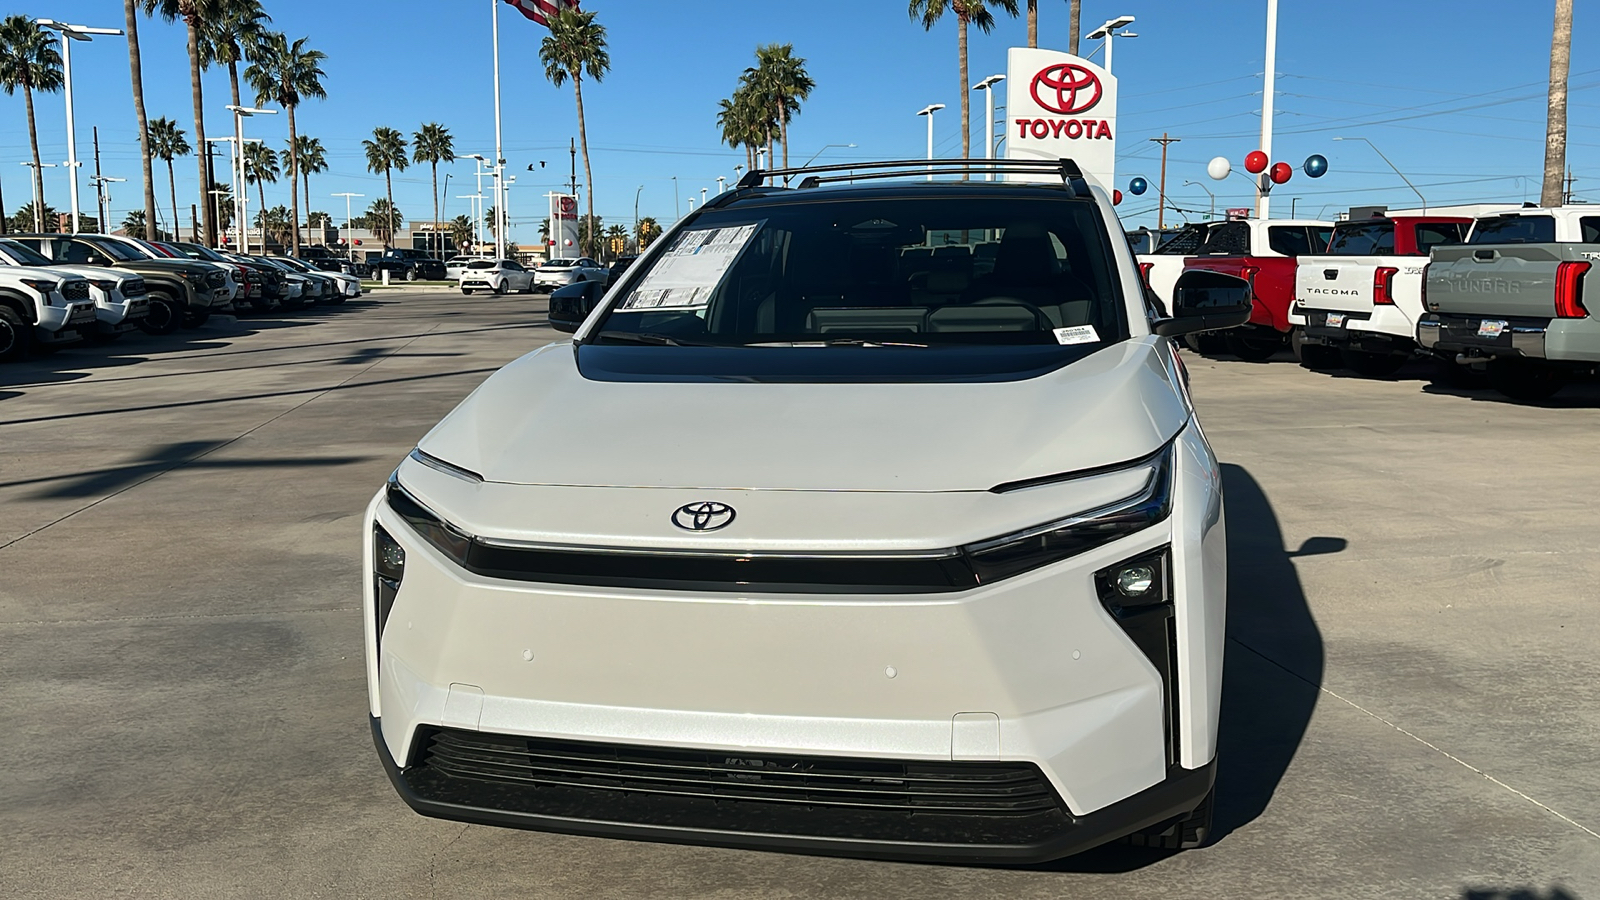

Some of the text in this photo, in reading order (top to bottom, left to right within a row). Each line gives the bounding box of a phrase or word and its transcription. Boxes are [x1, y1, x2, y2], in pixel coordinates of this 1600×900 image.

[1015, 118, 1113, 140] TOYOTA
[1306, 287, 1359, 296] TACOMA
[1447, 280, 1520, 294] TUNDRA
